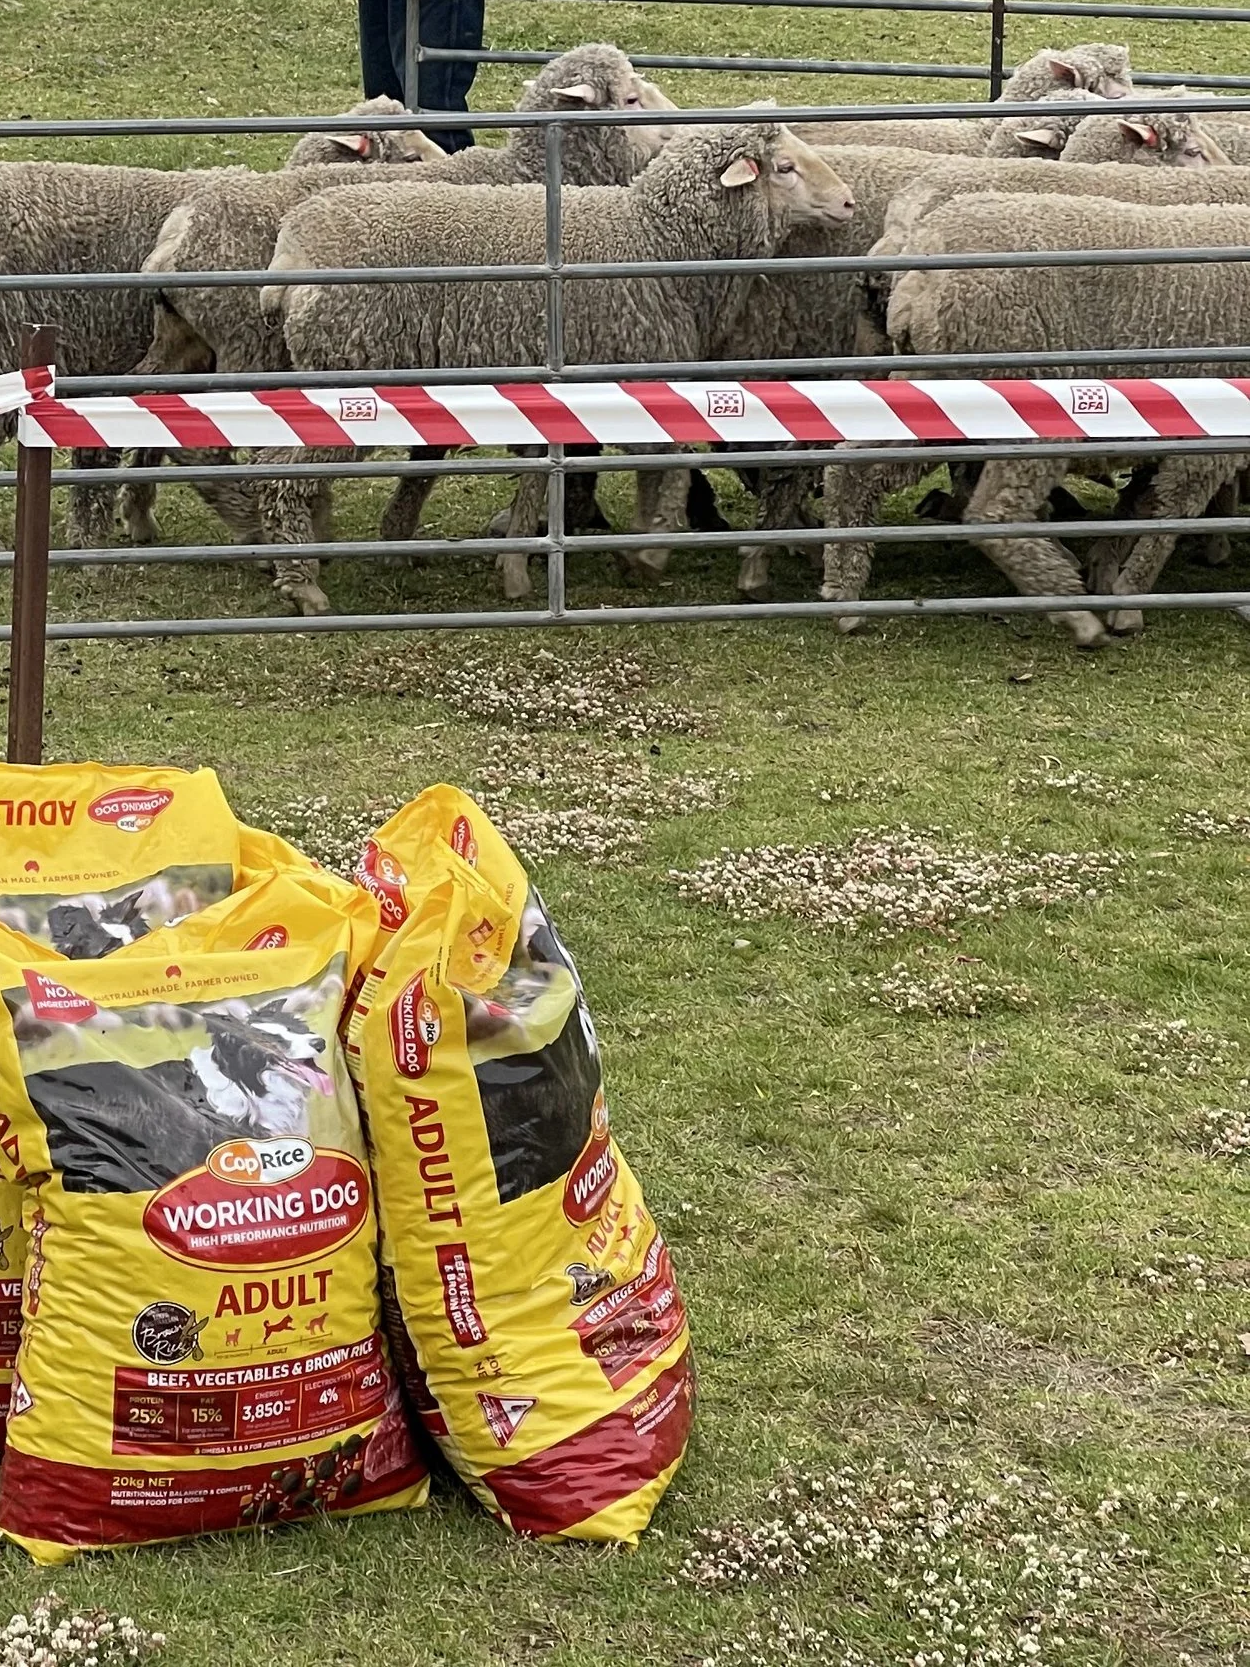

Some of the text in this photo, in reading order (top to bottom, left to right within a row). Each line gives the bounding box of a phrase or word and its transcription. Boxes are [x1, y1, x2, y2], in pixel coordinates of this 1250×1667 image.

[712, 404, 739, 415] CFA
[1076, 400, 1104, 411] CFA
[94, 794, 171, 816] WORKING DOG
[42, 873, 81, 883] FARMER
[376, 889, 403, 921] DOG
[93, 989, 150, 1003] AUSTRALIAN
[185, 977, 223, 990] FARMER
[36, 998, 91, 1010] INGREDIENT
[405, 1042, 421, 1073] DOG
[404, 1094, 463, 1227] ADULT
[573, 1146, 613, 1205] WORK
[162, 1180, 360, 1233] WORKING DOG
[190, 1214, 348, 1248] HIGH PERFORMANCE NUTRITION
[214, 1269, 334, 1319] ADULT
[446, 1272, 460, 1313] BROWN
[453, 1254, 483, 1342] BEEF, VEGETABLES
[451, 1310, 467, 1335] RICE
[147, 1372, 191, 1389] BEEF,
[194, 1364, 290, 1387] VEGETABLES
[291, 1362, 303, 1375] &
[305, 1347, 350, 1374] BROWN
[350, 1338, 374, 1359] RICE
[304, 1372, 352, 1392] ELECTROLYTES
[129, 1396, 165, 1405] PROTEIN
[200, 1396, 215, 1405] FAT
[254, 1389, 285, 1400] ENERGY
[318, 1386, 339, 1406] 4%
[128, 1408, 165, 1425] 25%
[191, 1407, 223, 1424] 15%
[242, 1400, 284, 1423] 3,850
[112, 1476, 175, 1489] 20kg NET
[110, 1490, 168, 1499] NUTRITIONALLY
[168, 1489, 208, 1498] BALANCED
[110, 1498, 145, 1507] PREMIUM
[145, 1498, 167, 1506] FOOD
[167, 1497, 183, 1505] FOR
